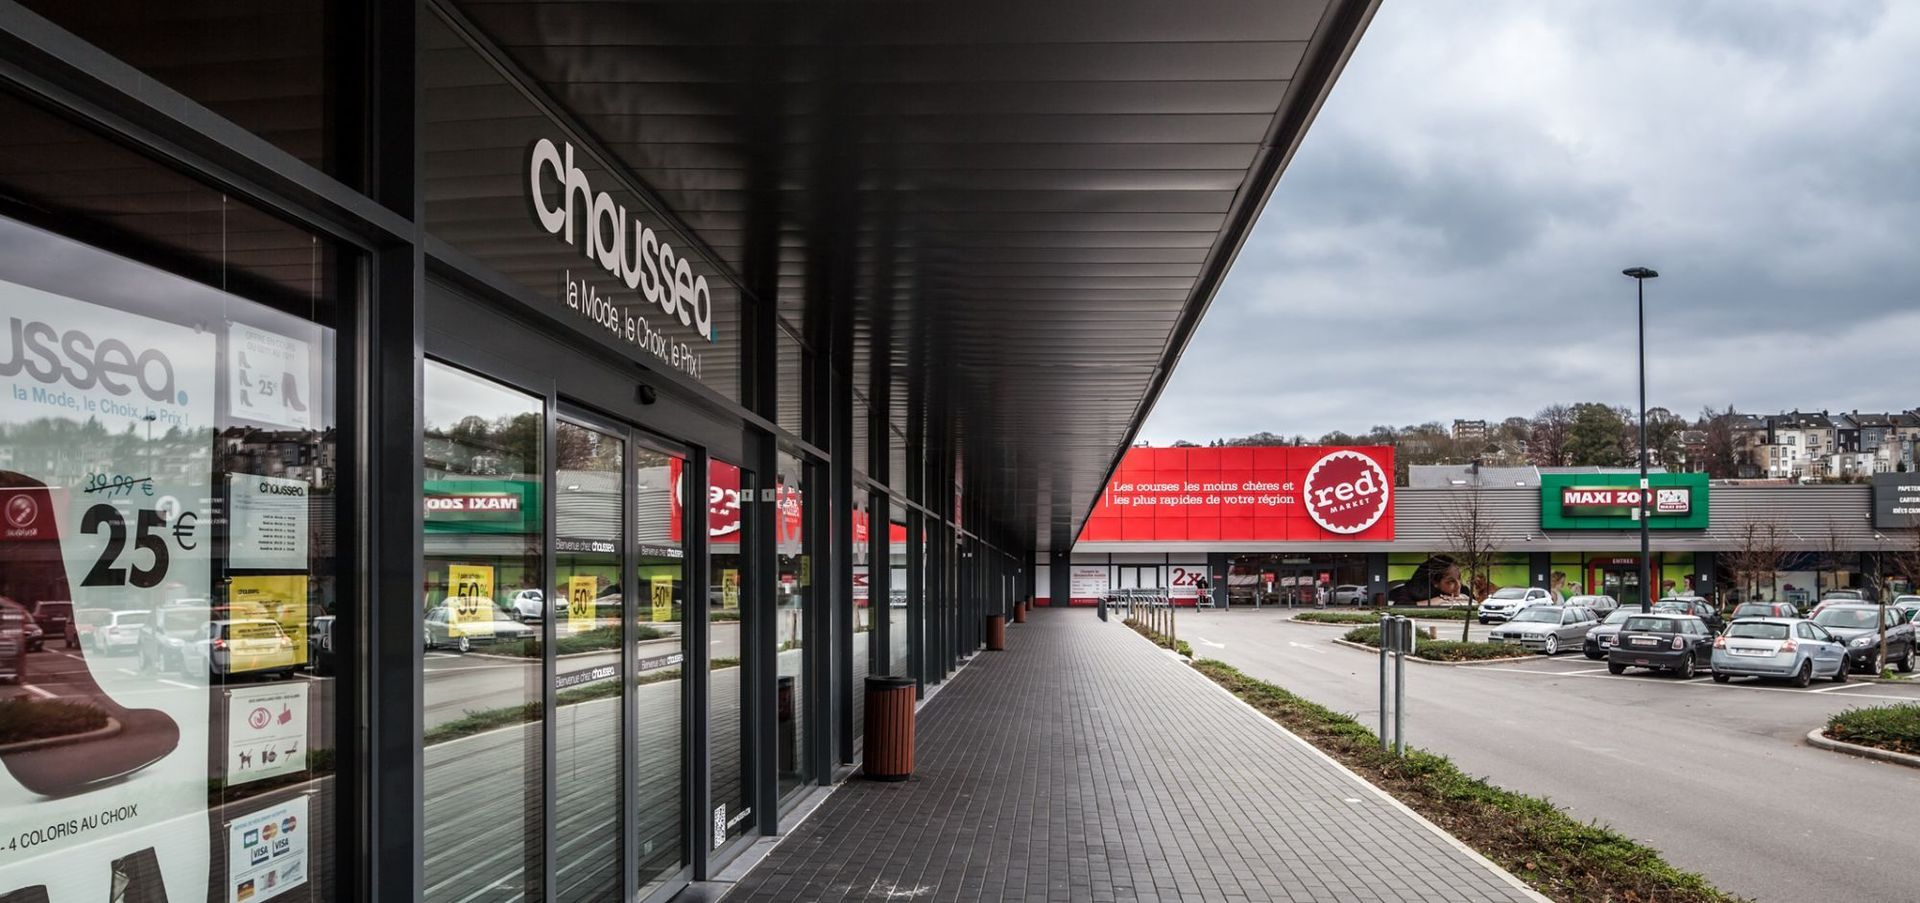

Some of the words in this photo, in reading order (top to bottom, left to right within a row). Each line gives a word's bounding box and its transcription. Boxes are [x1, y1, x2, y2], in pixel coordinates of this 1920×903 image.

[566, 269, 579, 310] la
[582, 279, 621, 339] Mode,
[625, 307, 635, 341] le
[637, 316, 668, 365] Choix,
[671, 336, 680, 366] le
[13, 383, 28, 401] la
[32, 387, 80, 412] Mode,
[84, 396, 96, 411] le
[100, 398, 142, 418] Choix,
[84, 471, 134, 499] 39,99
[1113, 481, 1133, 492] Les
[1136, 483, 1180, 492] courses
[1184, 481, 1200, 491] les
[1203, 481, 1238, 491] moins
[1242, 481, 1280, 491] chères
[1282, 482, 1295, 491] et
[1314, 469, 1378, 507] red
[1113, 495, 1130, 505] les
[1133, 495, 1157, 506] plus
[1160, 495, 1203, 507] rapides
[1205, 494, 1220, 504] de
[1223, 495, 1255, 504] votre
[1258, 494, 1295, 506] région
[1330, 498, 1370, 514] MARKET
[1564, 492, 1612, 504] MAXI
[1172, 567, 1201, 586] 2x
[9, 837, 17, 851] 4
[20, 819, 78, 849] COLORIS
[81, 814, 98, 831] AU
[101, 803, 138, 826] CHOIX
[253, 845, 268, 858] VISA
